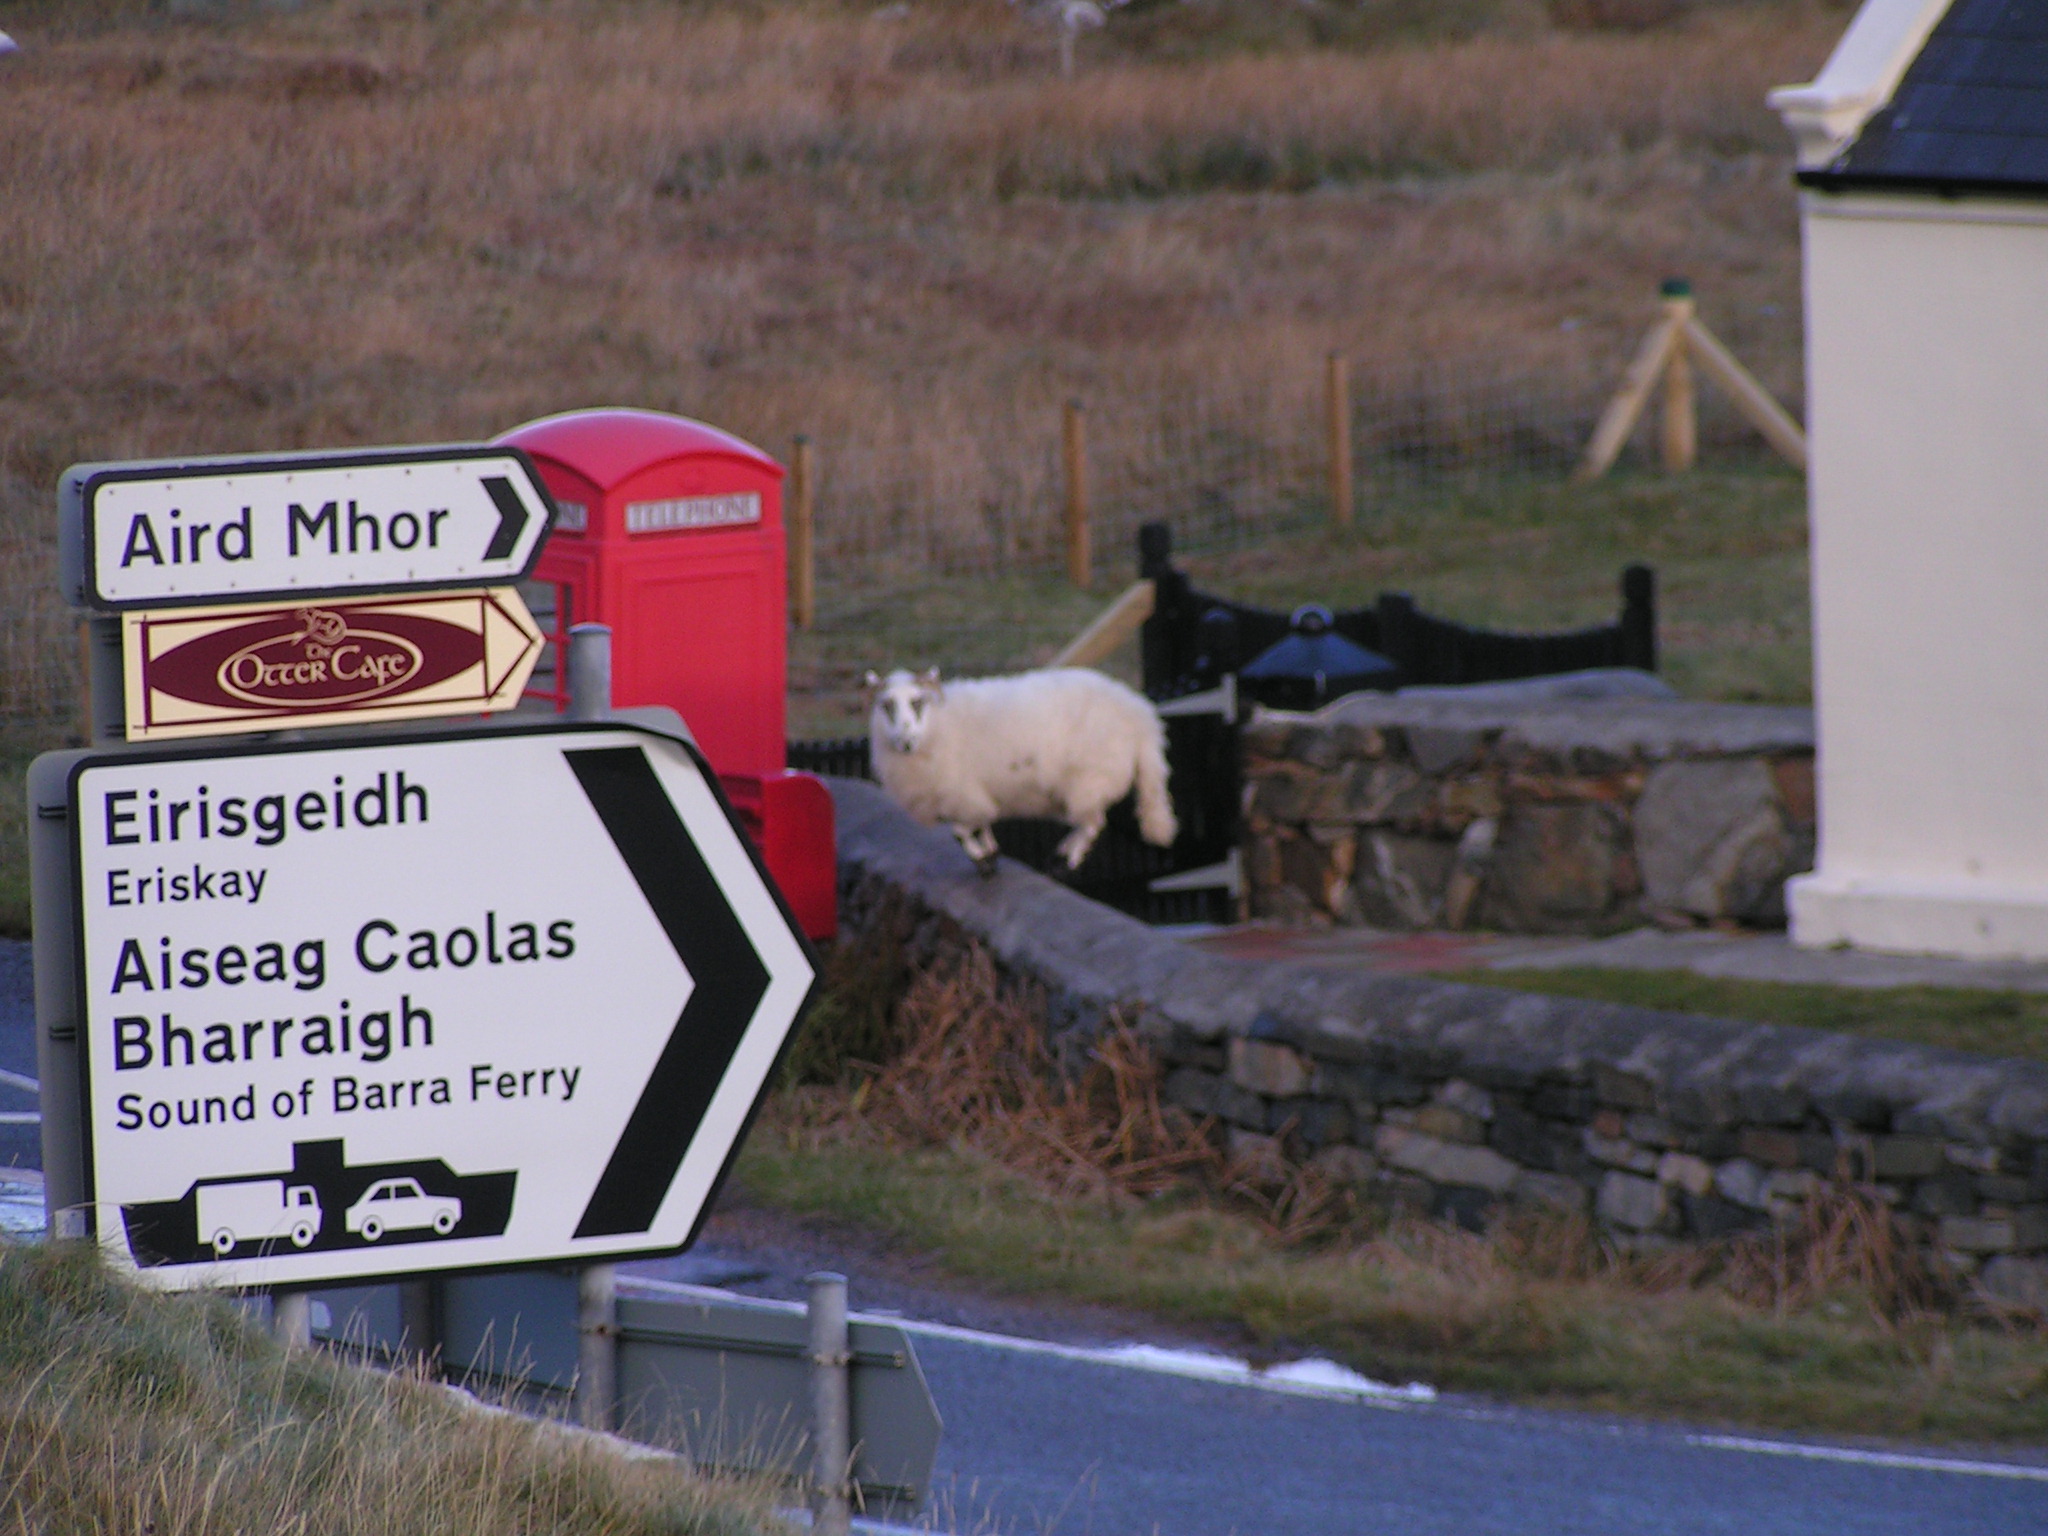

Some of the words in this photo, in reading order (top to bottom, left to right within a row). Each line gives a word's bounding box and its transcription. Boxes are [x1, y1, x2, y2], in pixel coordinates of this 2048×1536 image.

[121, 506, 253, 568] Aird
[287, 500, 450, 557] Mhor
[104, 770, 428, 846] Eirisgeidh
[107, 863, 267, 907] Eriskay
[110, 936, 326, 995] Aiseag
[355, 911, 576, 974] Caolas
[113, 994, 435, 1072] Bharraigh
[116, 1085, 256, 1131] Sound
[271, 1078, 314, 1119] of
[333, 1076, 451, 1113] Barra
[470, 1064, 582, 1102] Ferry
